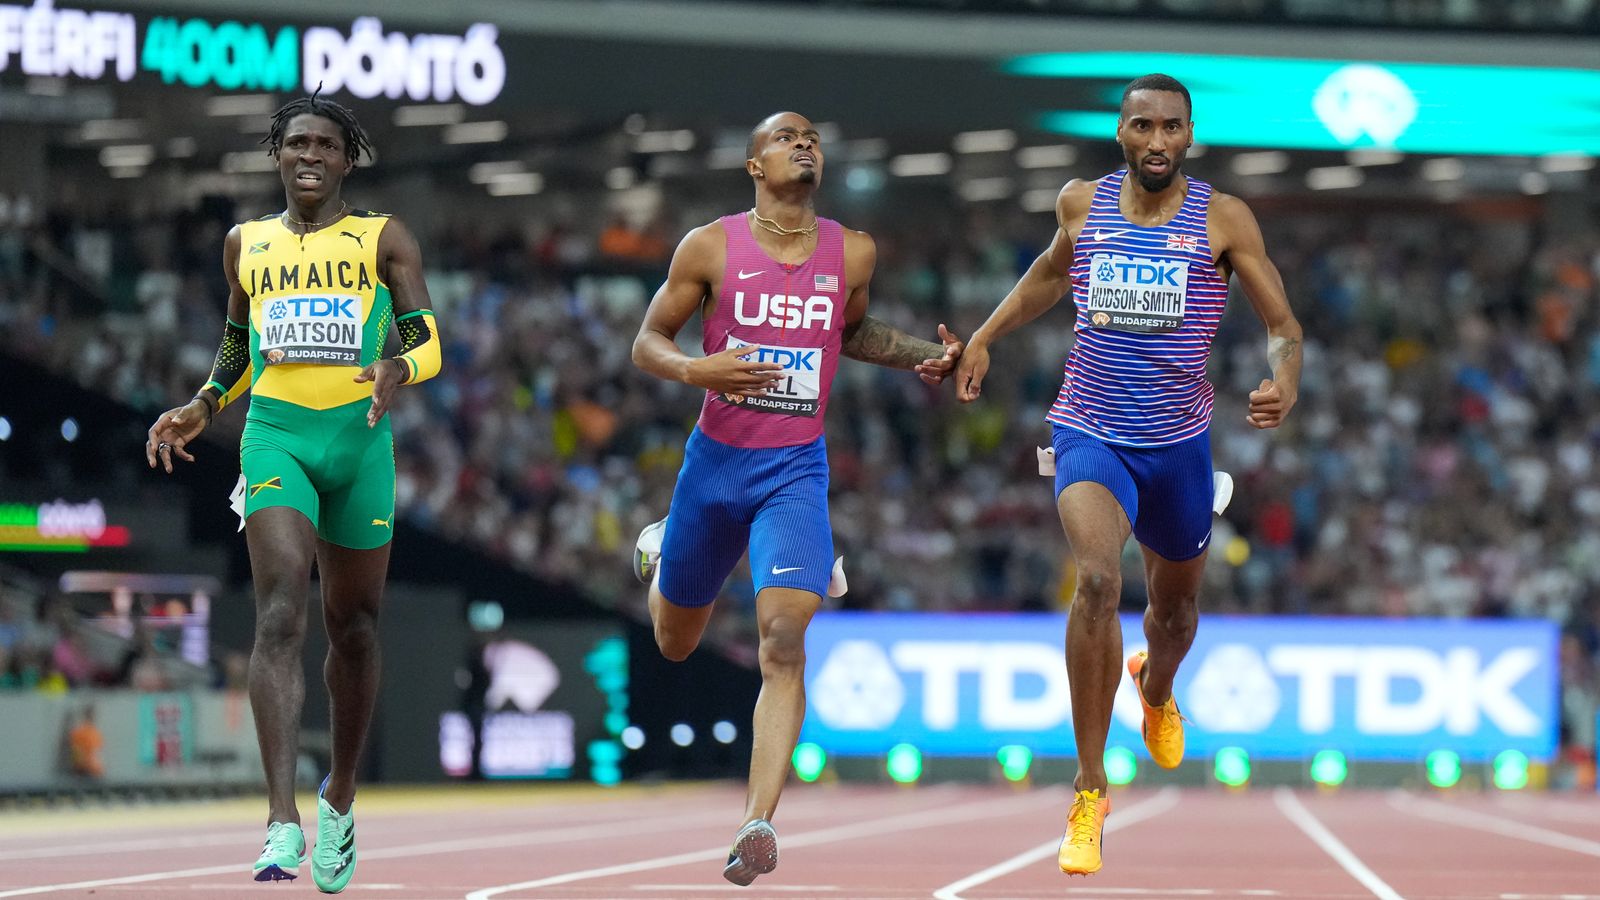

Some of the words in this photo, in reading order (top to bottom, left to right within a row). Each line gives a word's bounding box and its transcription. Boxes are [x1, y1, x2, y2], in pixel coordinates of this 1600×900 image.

[250, 261, 372, 297] JAMAICA
[1115, 263, 1179, 286] TDK
[288, 297, 355, 319] TDK
[734, 291, 834, 331] USA
[1090, 286, 1182, 313] HUDSON-SMITH
[266, 321, 356, 346] WATSON
[1113, 316, 1166, 328] BUDAPEST
[1166, 320, 1177, 328] 23
[288, 350, 342, 360] BUDAPEST
[343, 352, 356, 361] 23
[757, 347, 816, 371] TDK
[747, 396, 801, 411] BUDAPEST
[1264, 644, 1542, 737] TDK
